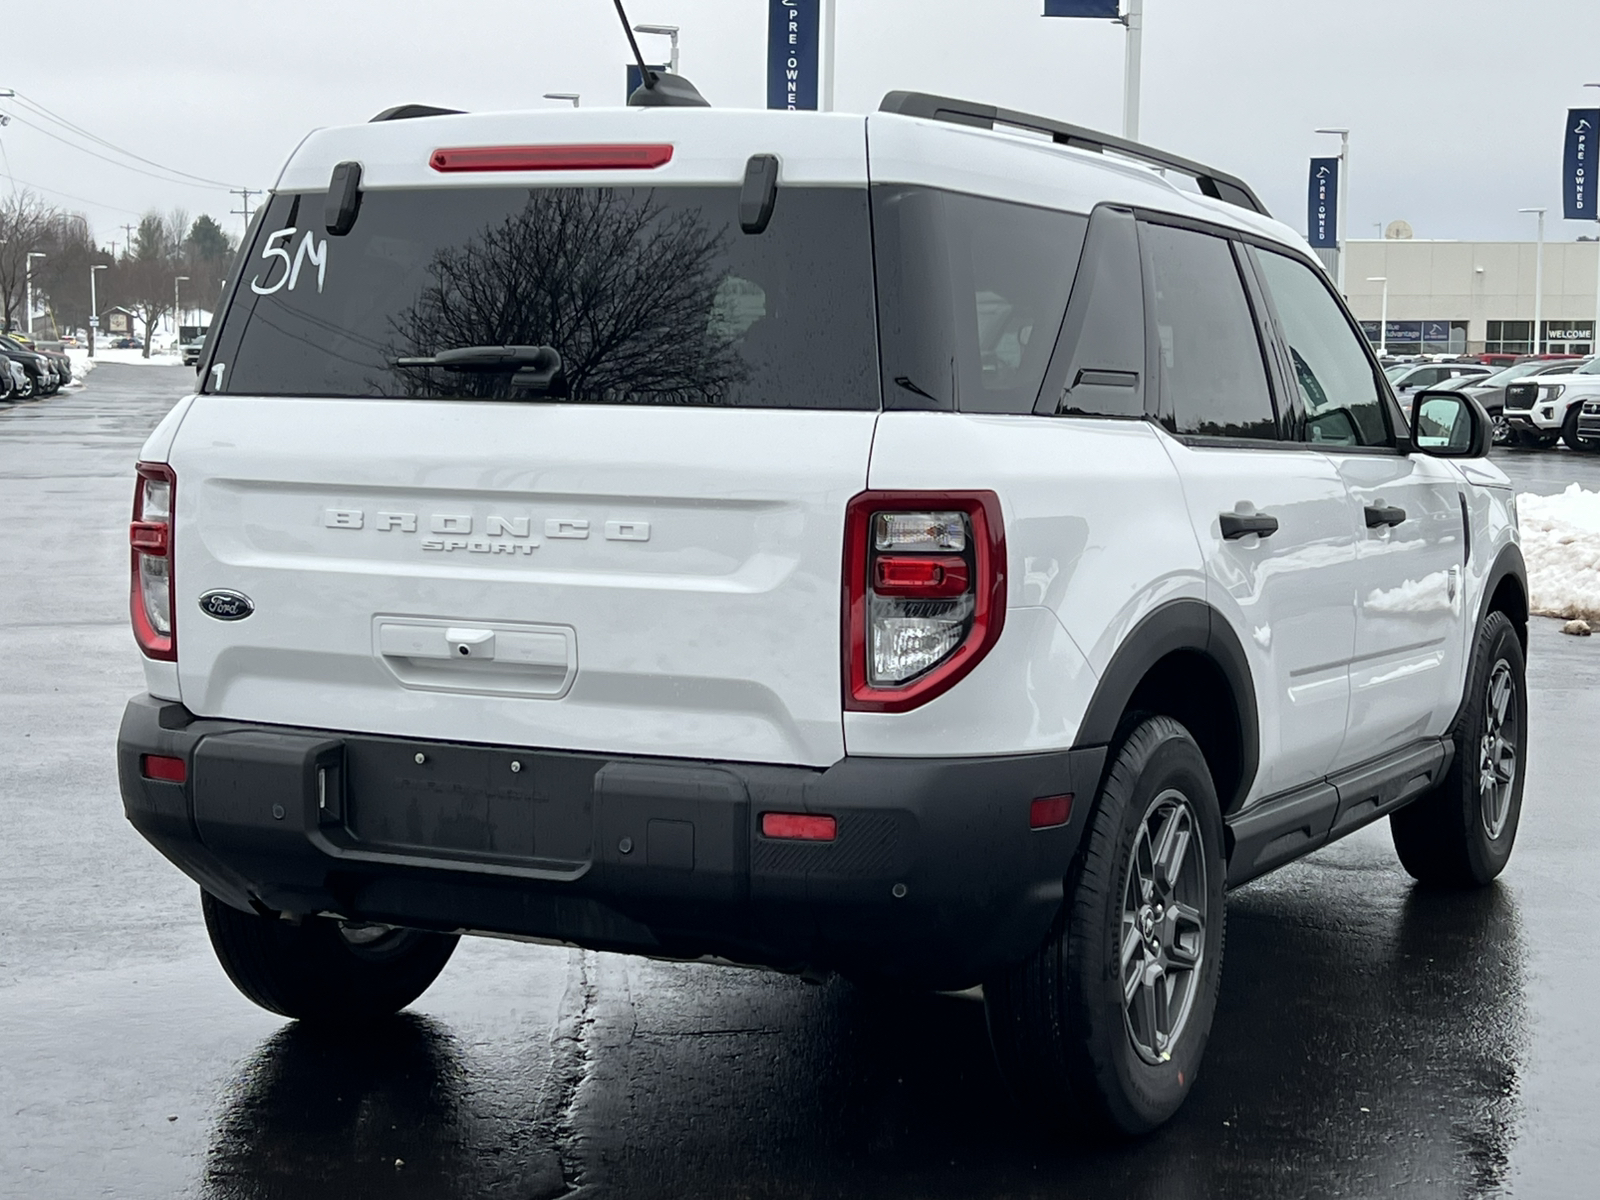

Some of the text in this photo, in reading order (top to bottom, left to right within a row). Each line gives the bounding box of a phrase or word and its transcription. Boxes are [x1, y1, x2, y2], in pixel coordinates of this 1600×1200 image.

[251, 227, 327, 294] 5M
[1549, 330, 1591, 339] WELCOME
[325, 508, 651, 542] BRONCO
[421, 539, 540, 556] SPORT
[208, 595, 240, 614] Ford
